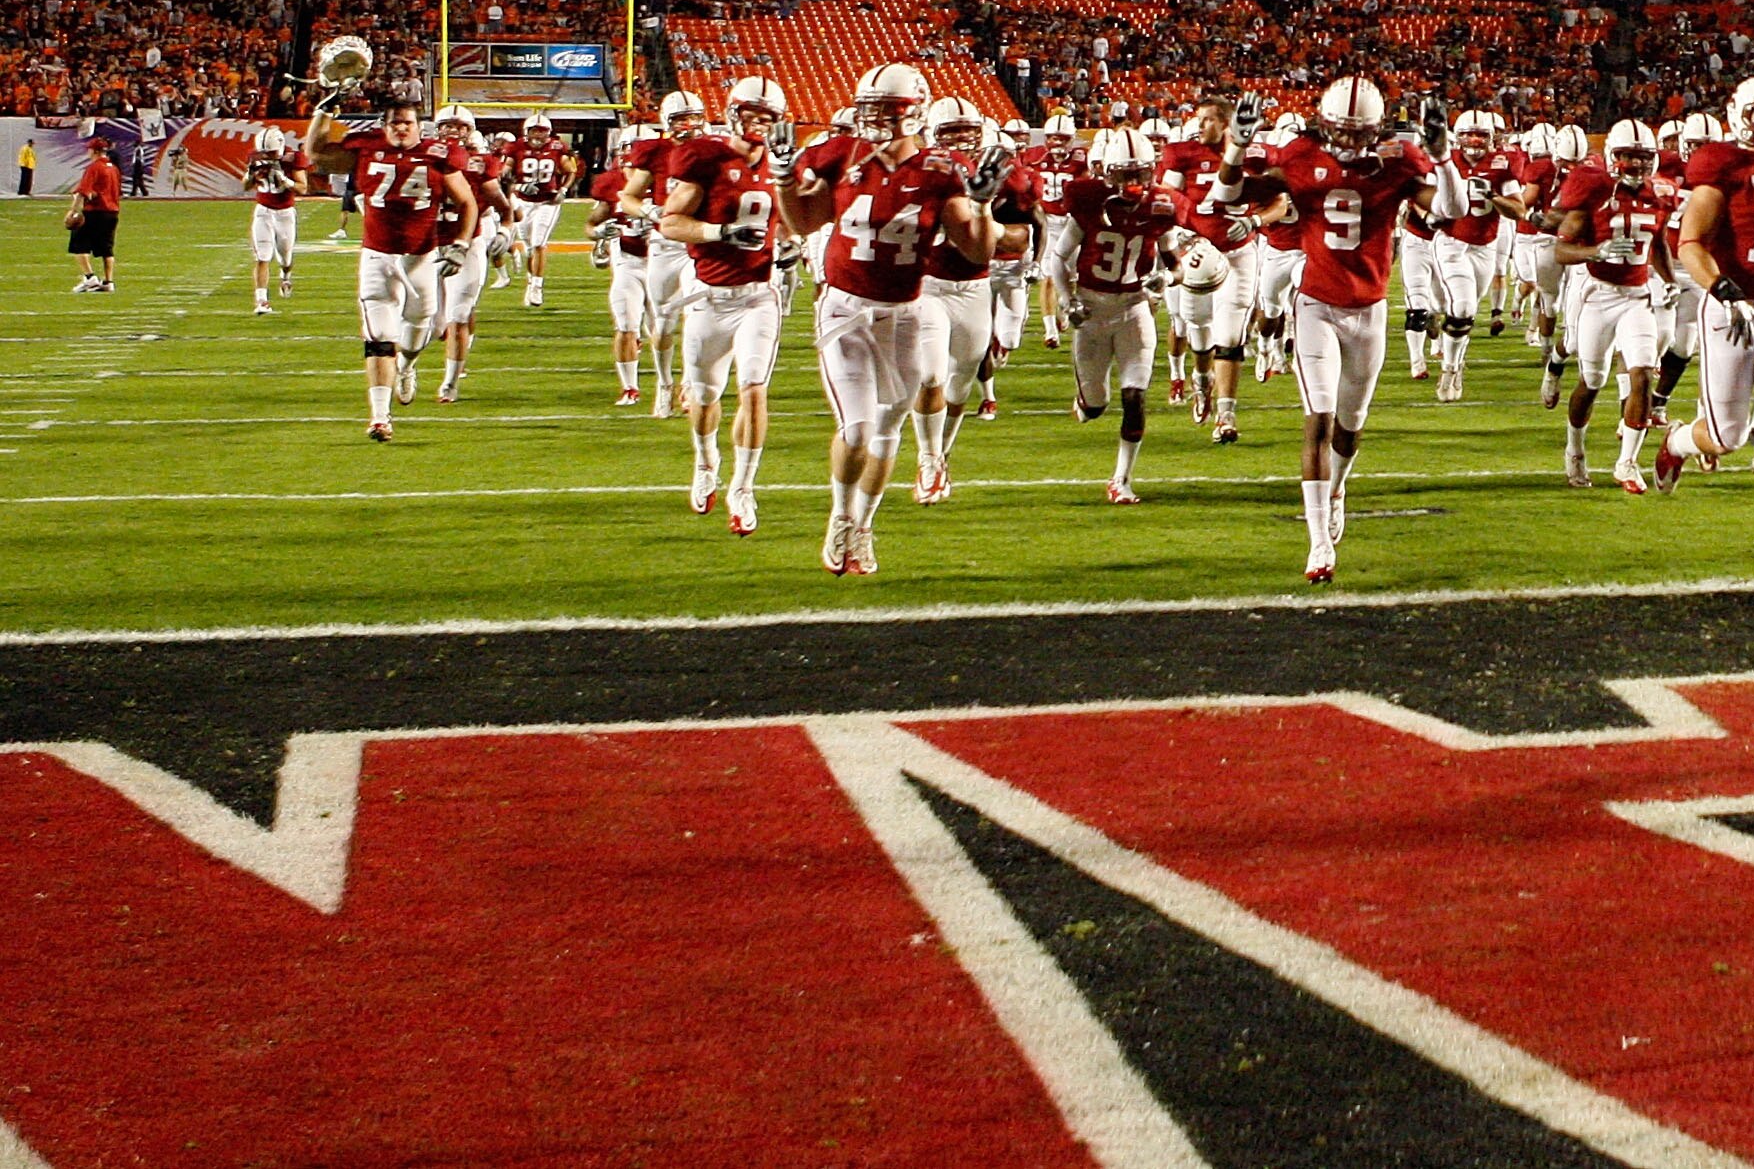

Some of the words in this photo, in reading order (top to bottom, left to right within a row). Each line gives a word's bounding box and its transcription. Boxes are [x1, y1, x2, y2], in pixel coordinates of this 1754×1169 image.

[367, 161, 432, 211] 74
[522, 157, 556, 184] 98
[840, 193, 923, 265] 44
[1323, 188, 1362, 251] 9
[1606, 213, 1656, 265] 15
[1091, 230, 1144, 285] 31
